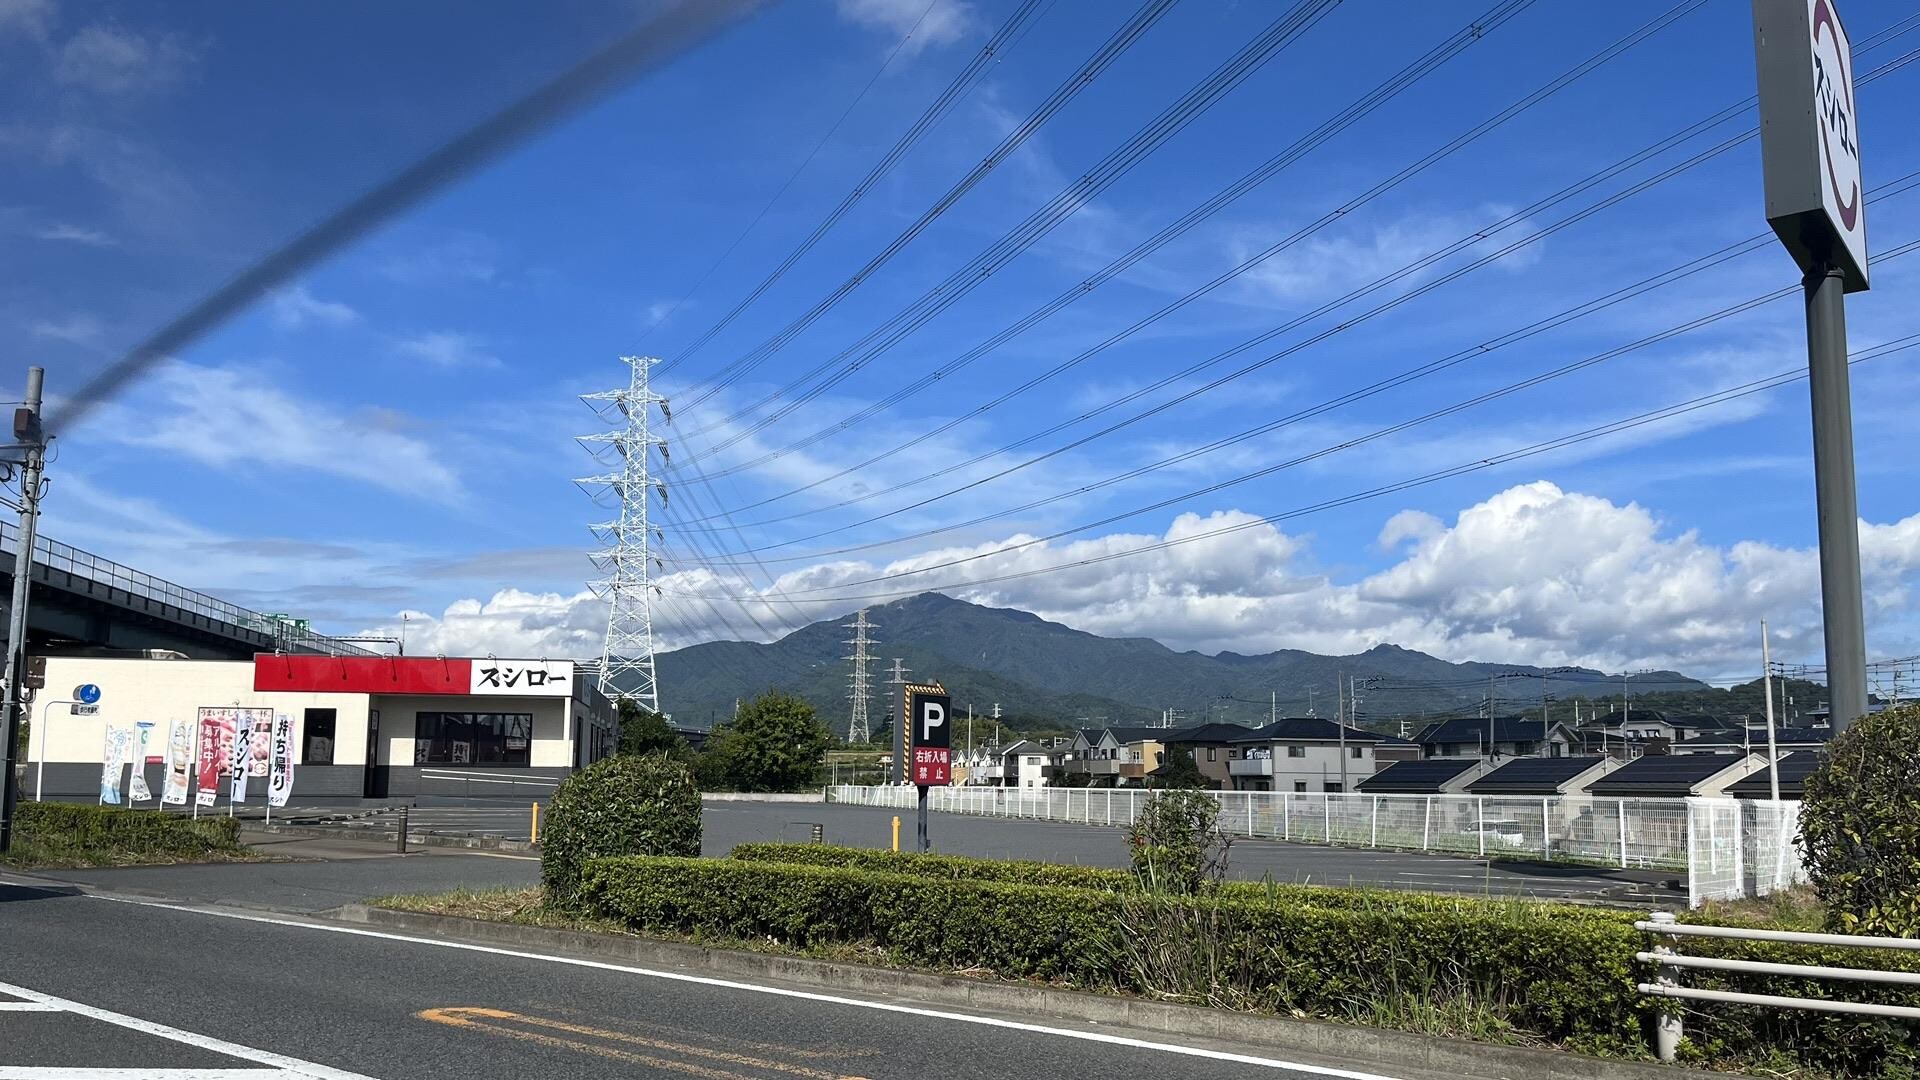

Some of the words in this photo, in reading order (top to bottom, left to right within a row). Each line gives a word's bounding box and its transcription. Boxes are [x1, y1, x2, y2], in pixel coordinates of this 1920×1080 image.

[1813, 49, 1857, 161] スシロー
[477, 666, 567, 689] スシロー
[923, 702, 945, 741] P
[232, 728, 250, 798] スシロー
[273, 719, 289, 791] 持ち帰り
[916, 750, 948, 764] 右折入場
[919, 767, 944, 780] 禁止
